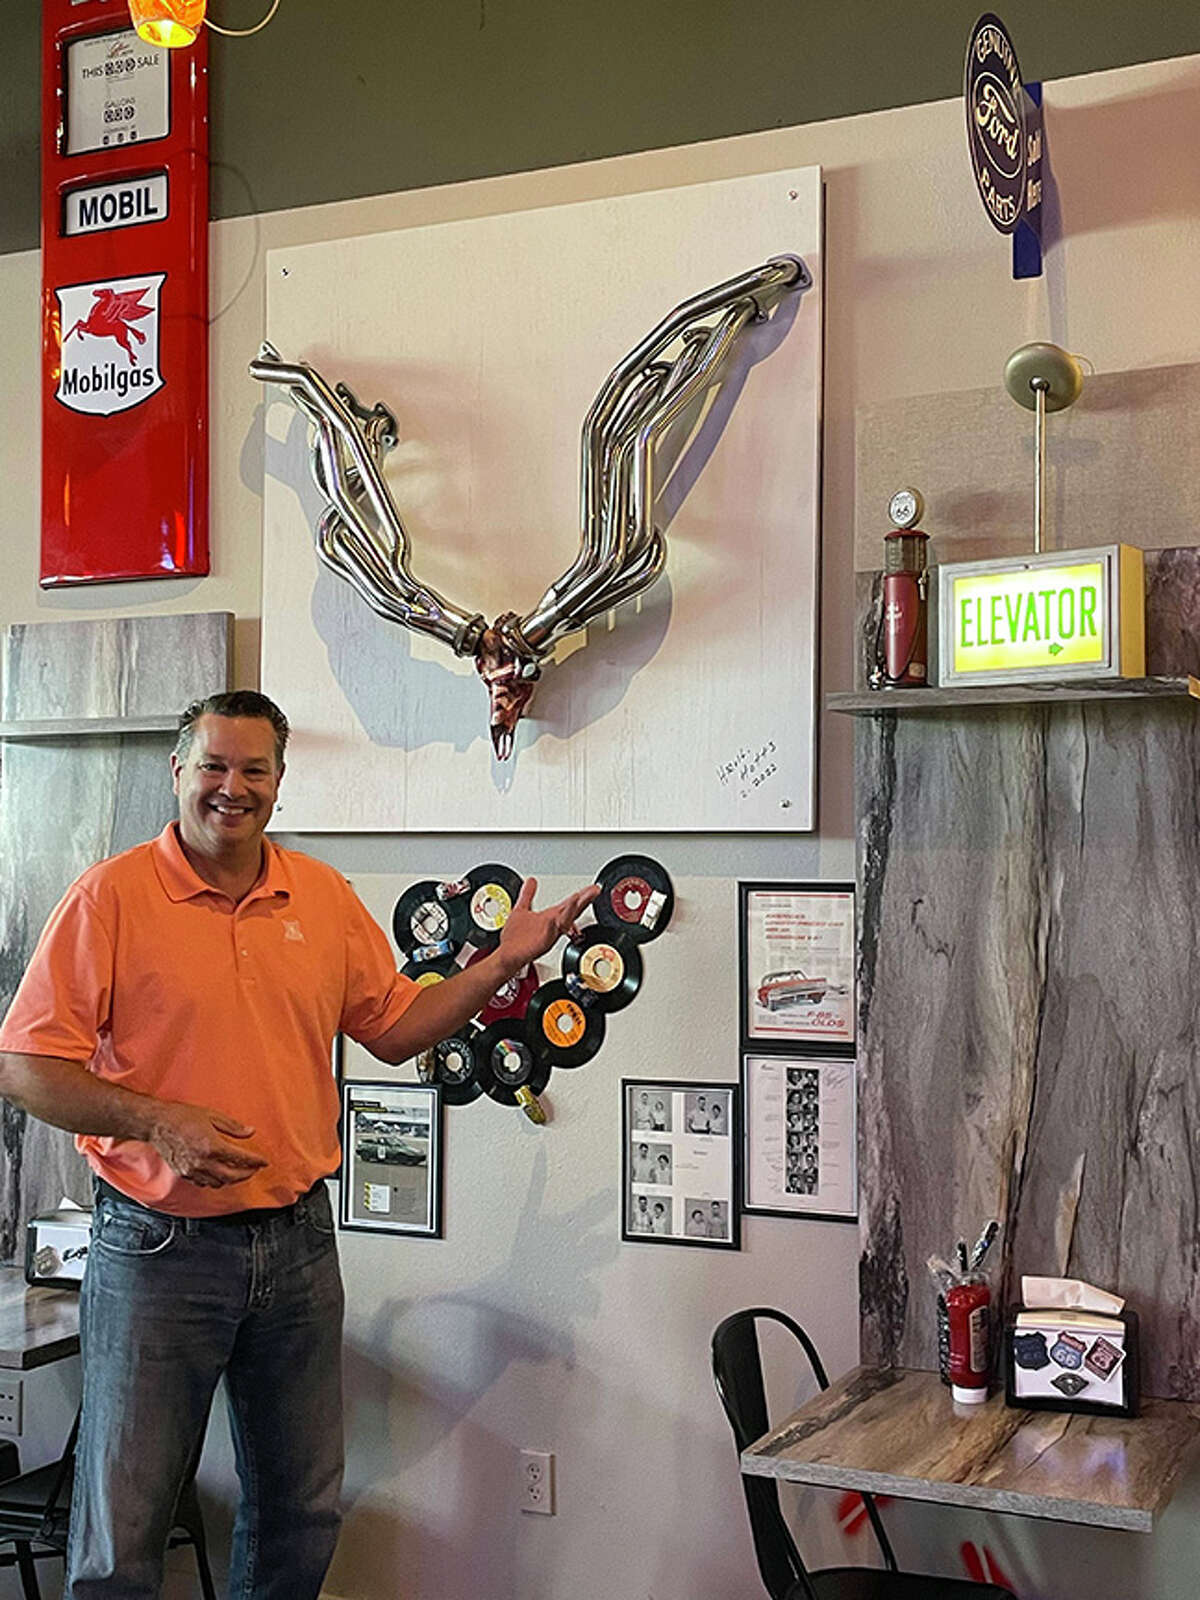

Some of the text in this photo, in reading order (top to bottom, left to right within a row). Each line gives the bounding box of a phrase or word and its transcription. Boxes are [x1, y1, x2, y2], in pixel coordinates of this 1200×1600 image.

[82, 65, 103, 79] THIS
[137, 54, 159, 69] SALE
[976, 83, 1019, 159] Ford
[79, 187, 158, 227] MOBIL
[980, 167, 1016, 220] PARTS
[62, 363, 154, 398] Mobilgas
[960, 586, 1097, 648] ELEVATOR
[1055, 1349, 1075, 1367] 66
